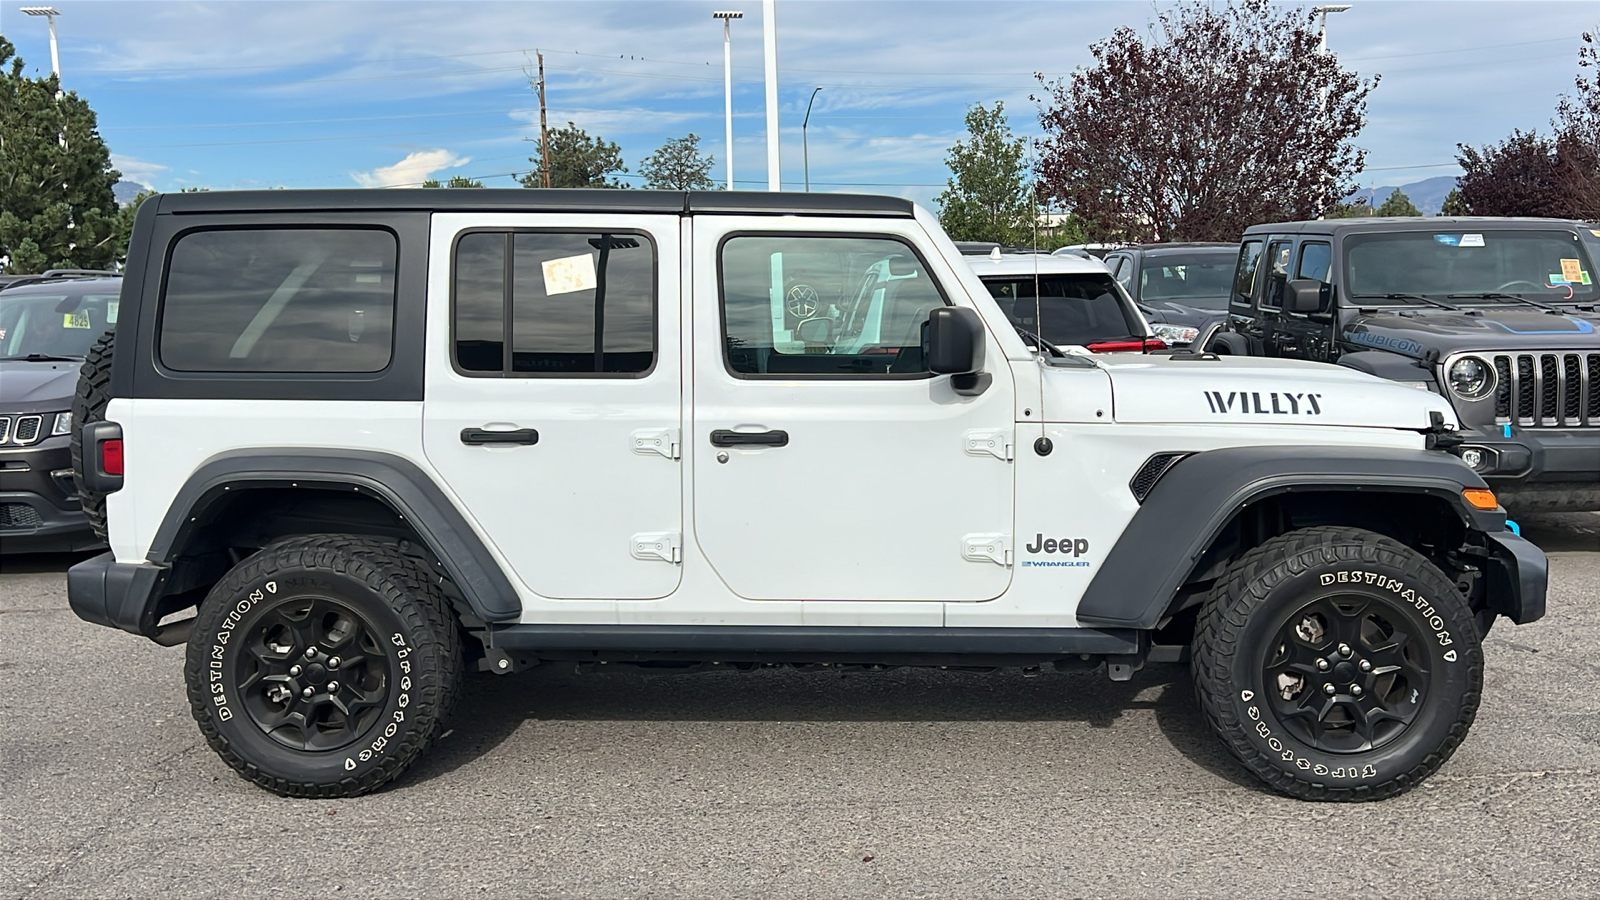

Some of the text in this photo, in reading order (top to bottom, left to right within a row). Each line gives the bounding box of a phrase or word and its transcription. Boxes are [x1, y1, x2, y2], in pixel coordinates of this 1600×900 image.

[1357, 331, 1422, 353] RUBICON
[1203, 391, 1322, 415] WILLYS
[1026, 533, 1089, 557] Jeep
[1319, 571, 1453, 646] DESTINATION
[211, 589, 264, 721] DESTINATION
